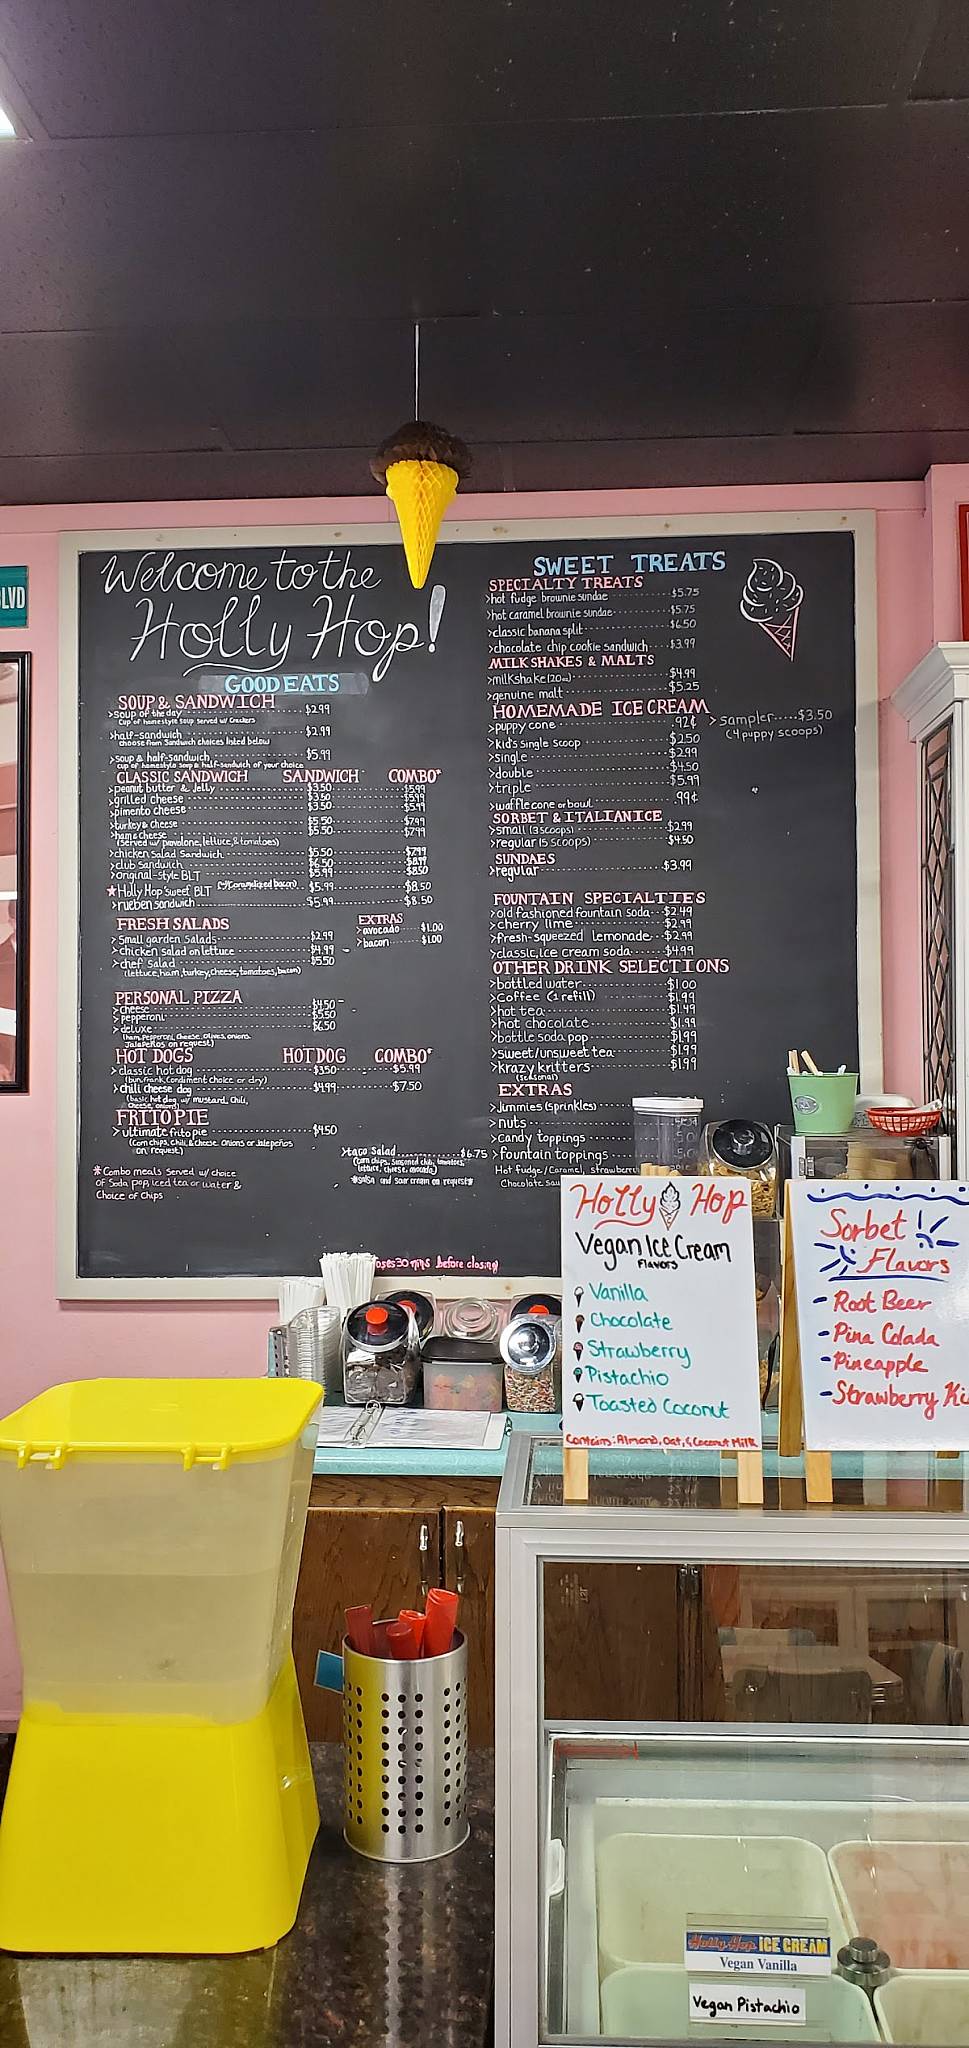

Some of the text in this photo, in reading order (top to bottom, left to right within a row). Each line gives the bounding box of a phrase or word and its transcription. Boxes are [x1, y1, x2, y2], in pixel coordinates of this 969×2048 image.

[100, 549, 382, 594] Welcome to the
[533, 550, 727, 576] SWEET TREATS
[488, 575, 644, 592] SPECIALTY TREATS
[0, 586, 26, 609] LVD
[490, 587, 700, 607] hot fudge brownie sundae $5.75
[129, 584, 446, 682] Holly Hop!
[492, 626, 526, 637] classic
[527, 624, 561, 636] banana
[561, 623, 584, 639] split
[493, 638, 697, 655] chocolate chip cookie sandwich $3.99
[588, 656, 597, 666] &
[601, 655, 655, 667] MALTS
[224, 673, 340, 694] GOOD EATS
[492, 680, 700, 704] genuine malt $5.25
[117, 693, 276, 711] SOUP & SANDWICH
[492, 698, 711, 720] HOMEMADE ICE CREAM
[718, 709, 833, 728] sampler $3.50
[113, 725, 331, 740] half-sandwich $2.99
[742, 729, 774, 743] puppy
[777, 724, 824, 739] scoops)
[494, 747, 698, 766] single $2.99
[117, 770, 170, 784] CLASSIC
[174, 769, 249, 783] SANDWICH
[283, 769, 360, 783] SANDWICH
[114, 784, 144, 796] peanut
[145, 783, 176, 793] butter
[180, 783, 191, 793] &
[114, 795, 147, 807] grilled
[492, 811, 549, 825] SORBET
[552, 812, 562, 824] &
[495, 838, 536, 851] regular
[495, 852, 556, 866] SUNDAES
[495, 858, 692, 882] regular $3.99
[492, 890, 707, 906] FOUNTAIN SPECIALTIES
[116, 913, 404, 931] FRESH SALADS EXTRAS
[496, 906, 693, 919] old fashioned fountain soda $2.49
[496, 918, 692, 932] cherry lime $2.99
[119, 945, 158, 957] chicken
[200, 945, 235, 956] lettuce
[492, 958, 730, 975] OTHER DRINK SELECTIONS
[496, 977, 582, 991] bottled water
[115, 989, 243, 1006] PERSONAL PIZZA
[497, 1004, 696, 1018] hot tea $1.49
[115, 1048, 148, 1064] HOT
[152, 1047, 194, 1064] DOGS
[282, 1047, 316, 1064] HOT
[316, 1047, 347, 1064] DOG
[498, 1083, 573, 1097] EXTRAS
[115, 1108, 210, 1126] FRITO PIE
[537, 1129, 587, 1148] toppings
[347, 1147, 368, 1157] taco
[460, 1147, 488, 1159] $6.75
[102, 1165, 132, 1178] Combo
[133, 1166, 163, 1177] meals
[569, 1182, 748, 1229] Holly Hop
[819, 1208, 908, 1243] Sorbet
[575, 1232, 732, 1271] Vegan Ice Cream
[857, 1247, 950, 1274] Flavors
[466, 1255, 499, 1274] closing
[637, 1257, 679, 1270] Flavors
[588, 1282, 649, 1302] Vanilla
[832, 1289, 932, 1314] Root Beer
[590, 1310, 673, 1331] Chocolate
[833, 1321, 941, 1347] Pina Colada
[586, 1339, 692, 1369] Strawberry
[832, 1352, 929, 1378] Pineapple
[585, 1366, 670, 1387] Pistachio
[586, 1393, 731, 1420] Toasted Coconut
[831, 1379, 940, 1420] Strawberry
[758, 1936, 781, 1953] ICE
[782, 1937, 828, 1955] CREAM
[720, 1956, 798, 1972] Vegan Vanilla
[692, 1995, 801, 2018] Vegan Pistachio
